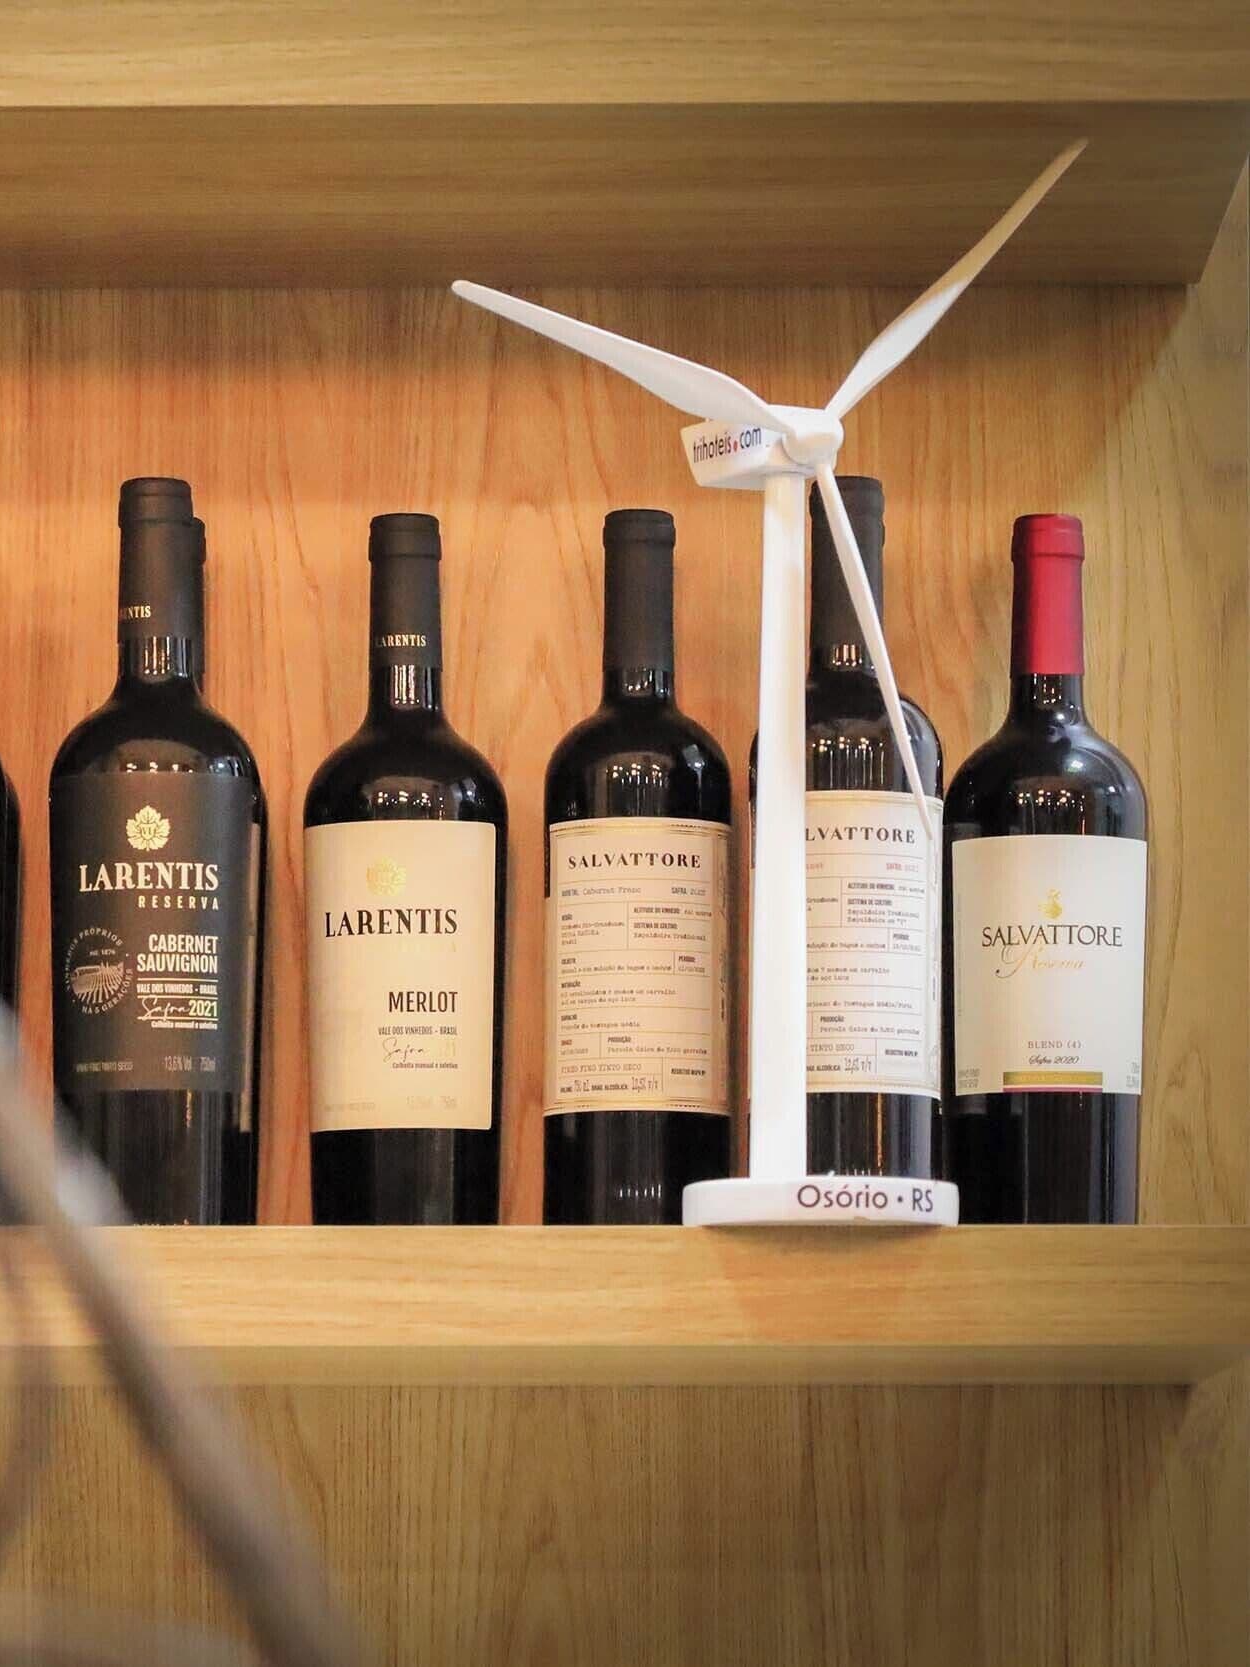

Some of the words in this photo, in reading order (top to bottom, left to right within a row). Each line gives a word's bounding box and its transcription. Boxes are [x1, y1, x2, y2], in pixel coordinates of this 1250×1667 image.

[805, 827, 915, 844] LVATTORE
[568, 853, 701, 869] SALVATTORE
[79, 862, 220, 892] LARENTIS
[138, 895, 220, 910] RESERVA
[325, 908, 458, 938] LARENTIS
[149, 933, 219, 954] CABERNET
[982, 924, 1123, 947] SALVATTORE
[137, 954, 218, 974] SAUVIGNON
[188, 1000, 218, 1017] 2021
[388, 991, 458, 1013] MERLOT
[1028, 1040, 1063, 1049] BLEND
[1067, 1040, 1082, 1050] (4)
[1054, 1055, 1080, 1065] 2020
[797, 1183, 888, 1208] Osório
[912, 1187, 934, 1213] RS
